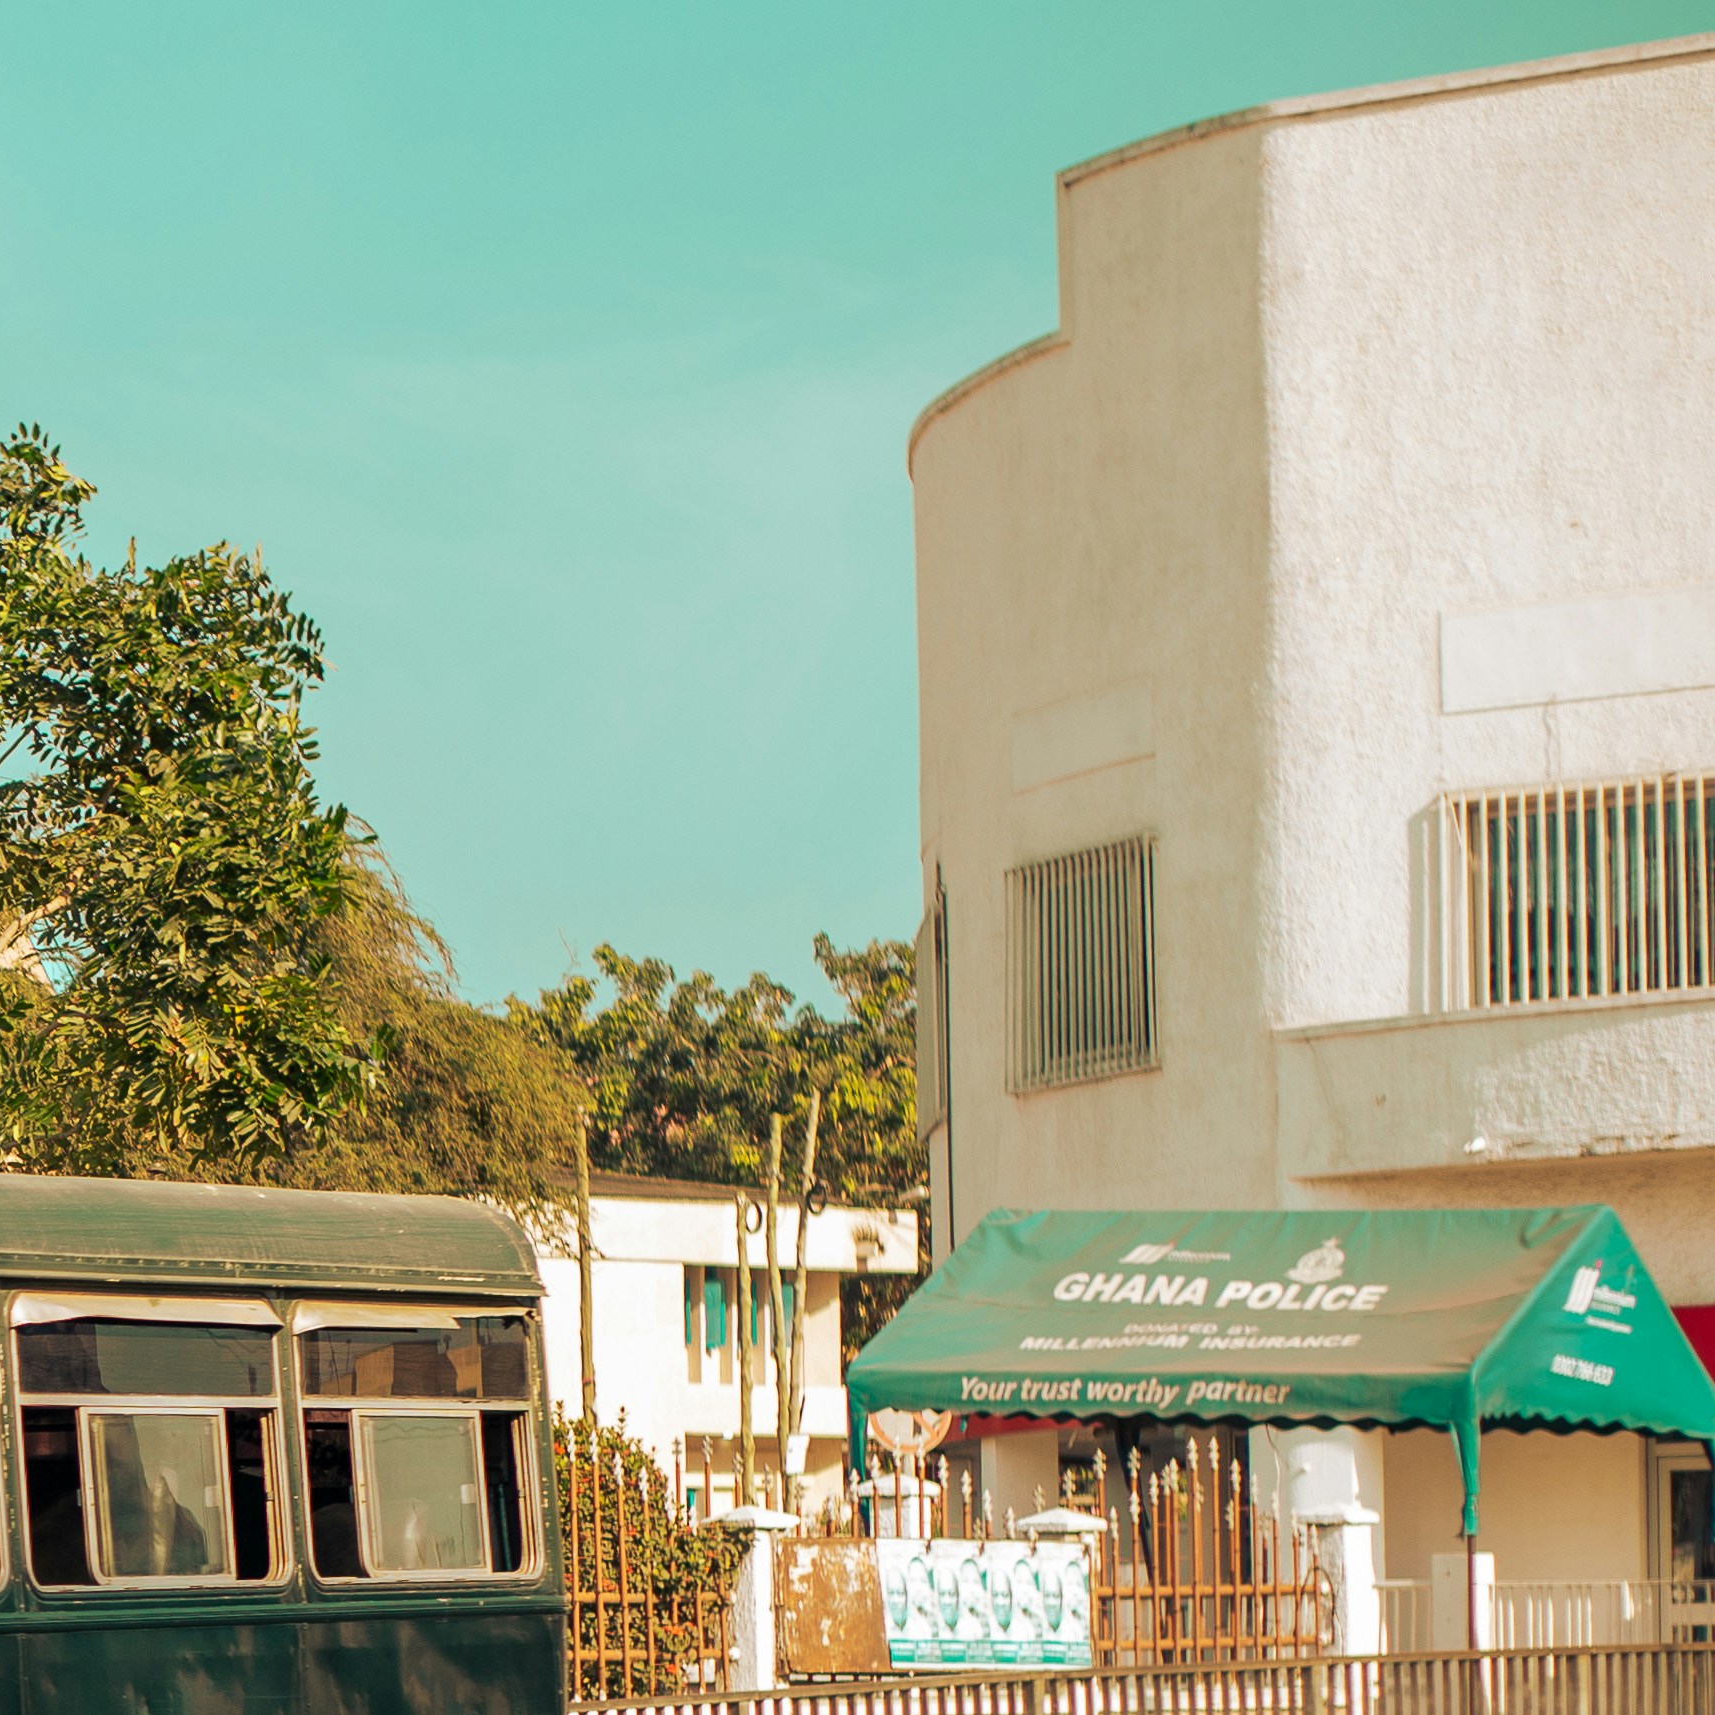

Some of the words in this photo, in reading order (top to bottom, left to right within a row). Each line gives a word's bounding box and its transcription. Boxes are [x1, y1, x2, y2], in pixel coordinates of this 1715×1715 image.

[1052, 1272, 1209, 1306] GHANA
[1215, 1279, 1389, 1311] POLICE
[1019, 1335, 1190, 1350] MILLENNIUM
[1198, 1333, 1363, 1350] INSURANCE
[960, 1376, 1017, 1401] Your
[1020, 1376, 1083, 1401] trust
[1086, 1376, 1181, 1410] worthy
[1184, 1378, 1292, 1406] partner
